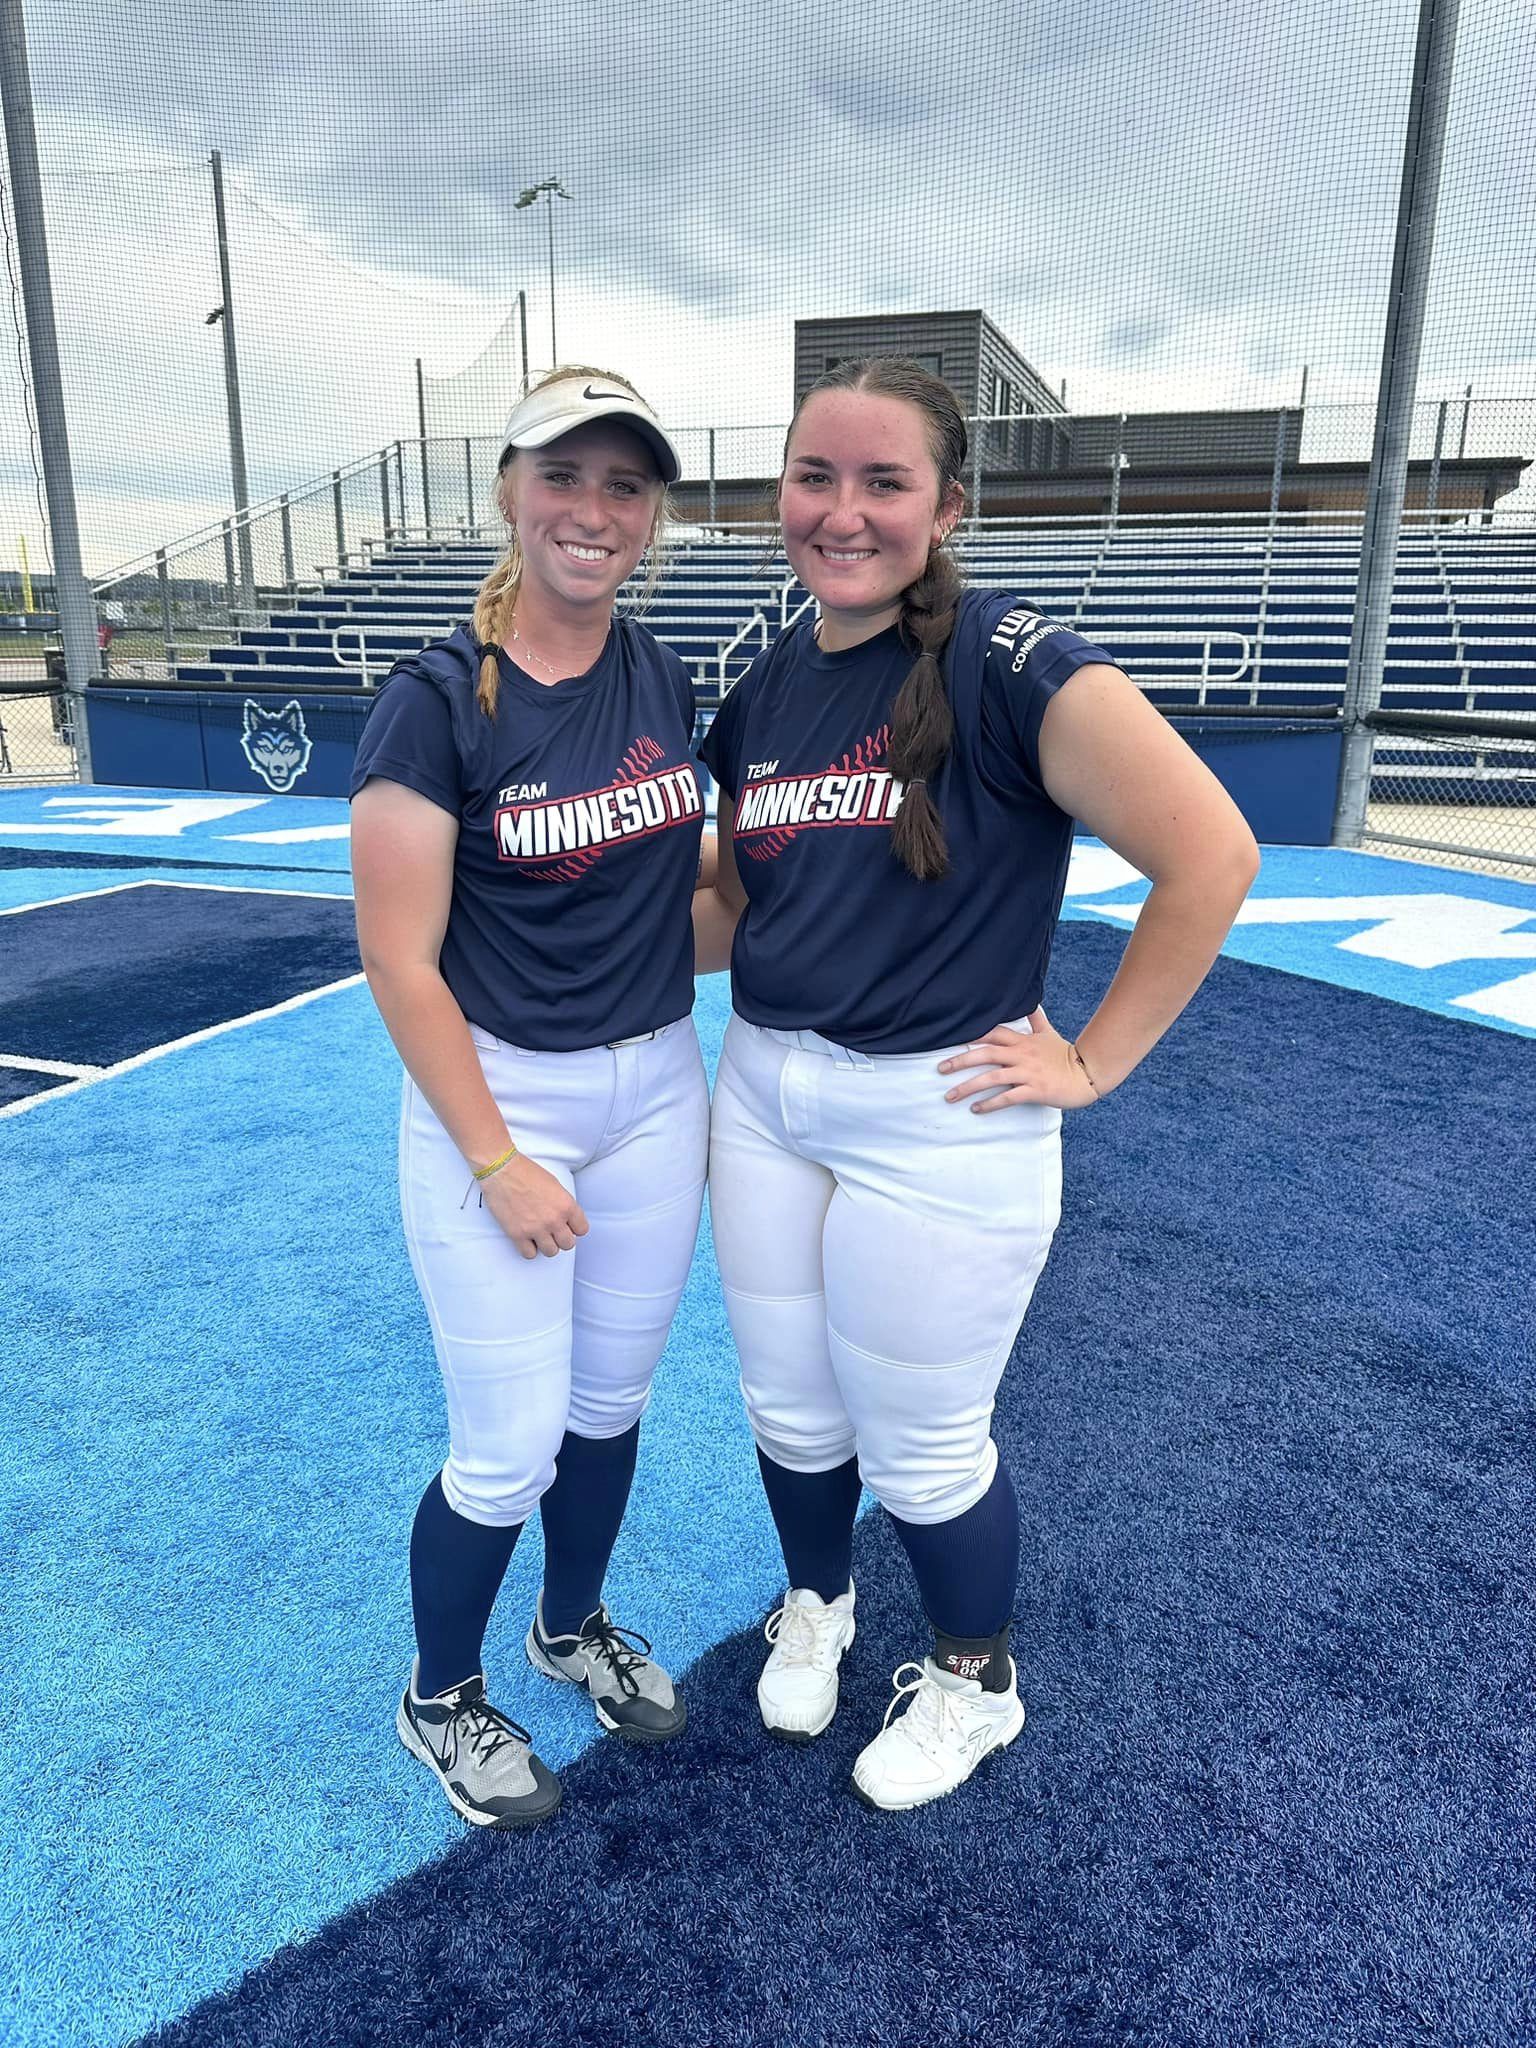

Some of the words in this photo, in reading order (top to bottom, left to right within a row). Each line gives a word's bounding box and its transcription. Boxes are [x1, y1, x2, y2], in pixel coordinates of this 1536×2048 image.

[747, 760, 780, 780] TEAM
[498, 781, 548, 805] TEAM
[499, 767, 701, 857] MINNESOTA
[959, 1666, 980, 1677] OK
